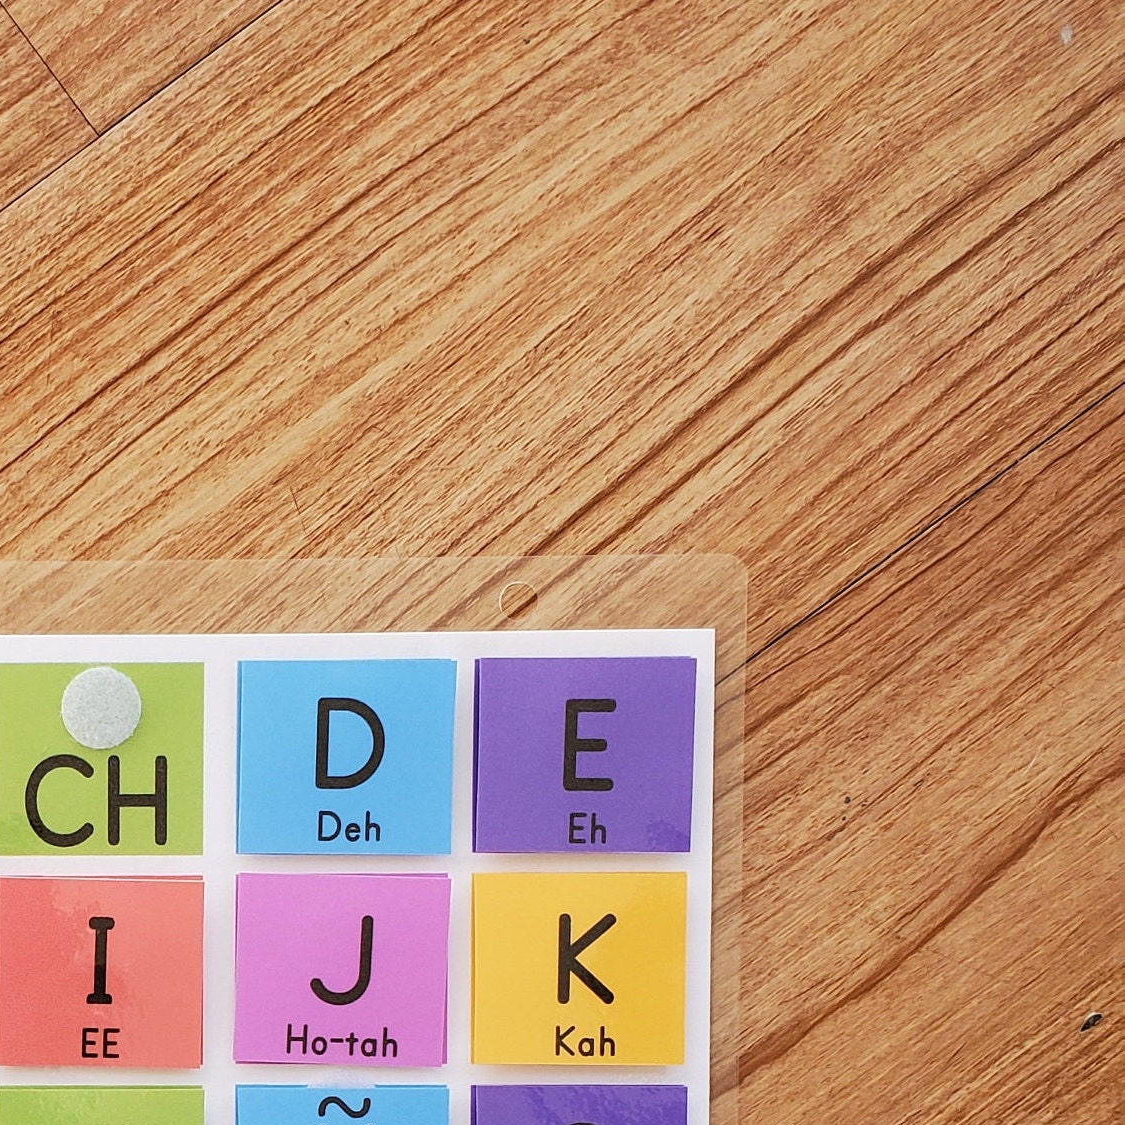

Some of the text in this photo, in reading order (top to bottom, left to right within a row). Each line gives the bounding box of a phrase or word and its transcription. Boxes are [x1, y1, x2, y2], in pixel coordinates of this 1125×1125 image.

[315, 697, 386, 790] D
[562, 698, 617, 792] E
[24, 753, 168, 848] CH
[317, 810, 381, 843] Deh
[569, 812, 607, 844] Eh
[86, 916, 116, 1005] I
[309, 915, 374, 1006] J
[557, 913, 617, 1005] K
[81, 1027, 121, 1059] EE
[286, 1023, 398, 1058] Ho-tah
[555, 1025, 616, 1057] Kah
